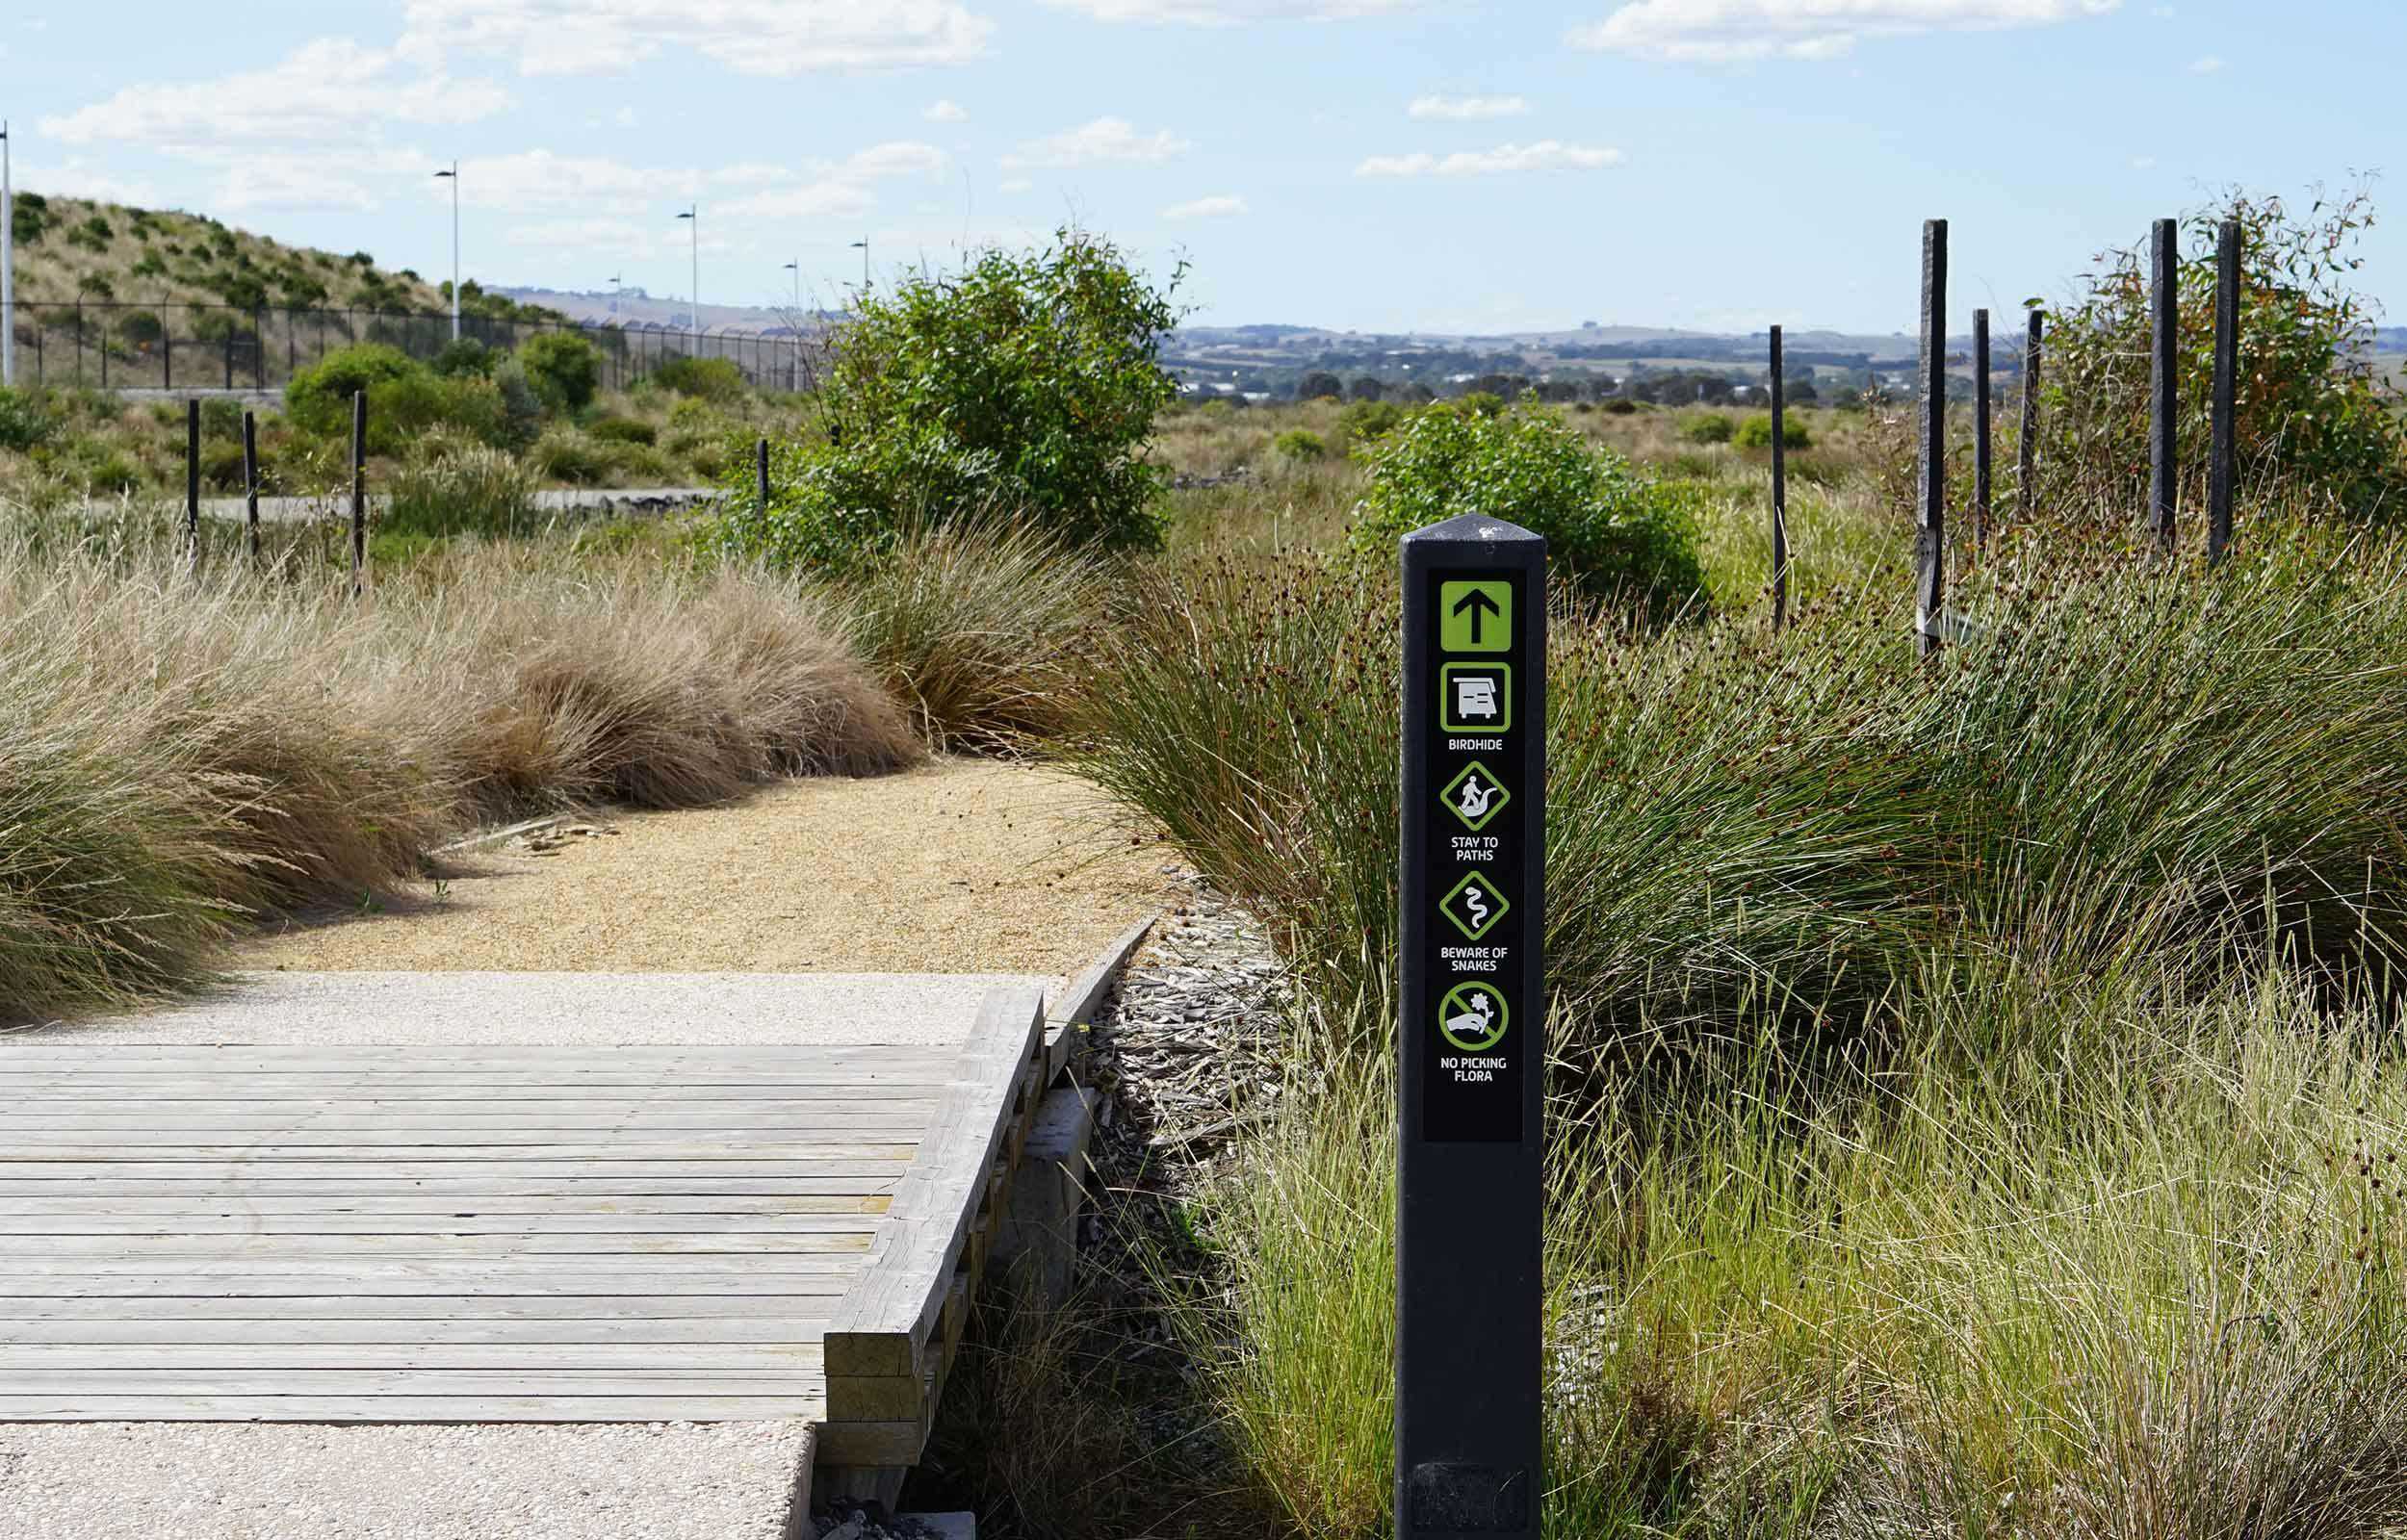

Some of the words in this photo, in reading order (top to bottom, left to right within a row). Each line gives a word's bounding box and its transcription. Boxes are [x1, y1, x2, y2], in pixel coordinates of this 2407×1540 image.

[1449, 739, 1502, 750] BIRDHIDE
[1452, 837, 1480, 848] STAY
[1483, 837, 1498, 848] TO
[1457, 850, 1493, 860] PATHS
[1441, 947, 1488, 958] BEWARE
[1492, 947, 1508, 958] OF
[1452, 961, 1496, 971] SNAKES
[1441, 1058, 1458, 1068] NO
[1462, 1058, 1506, 1068] PICKING
[1455, 1070, 1492, 1081] FLORA
